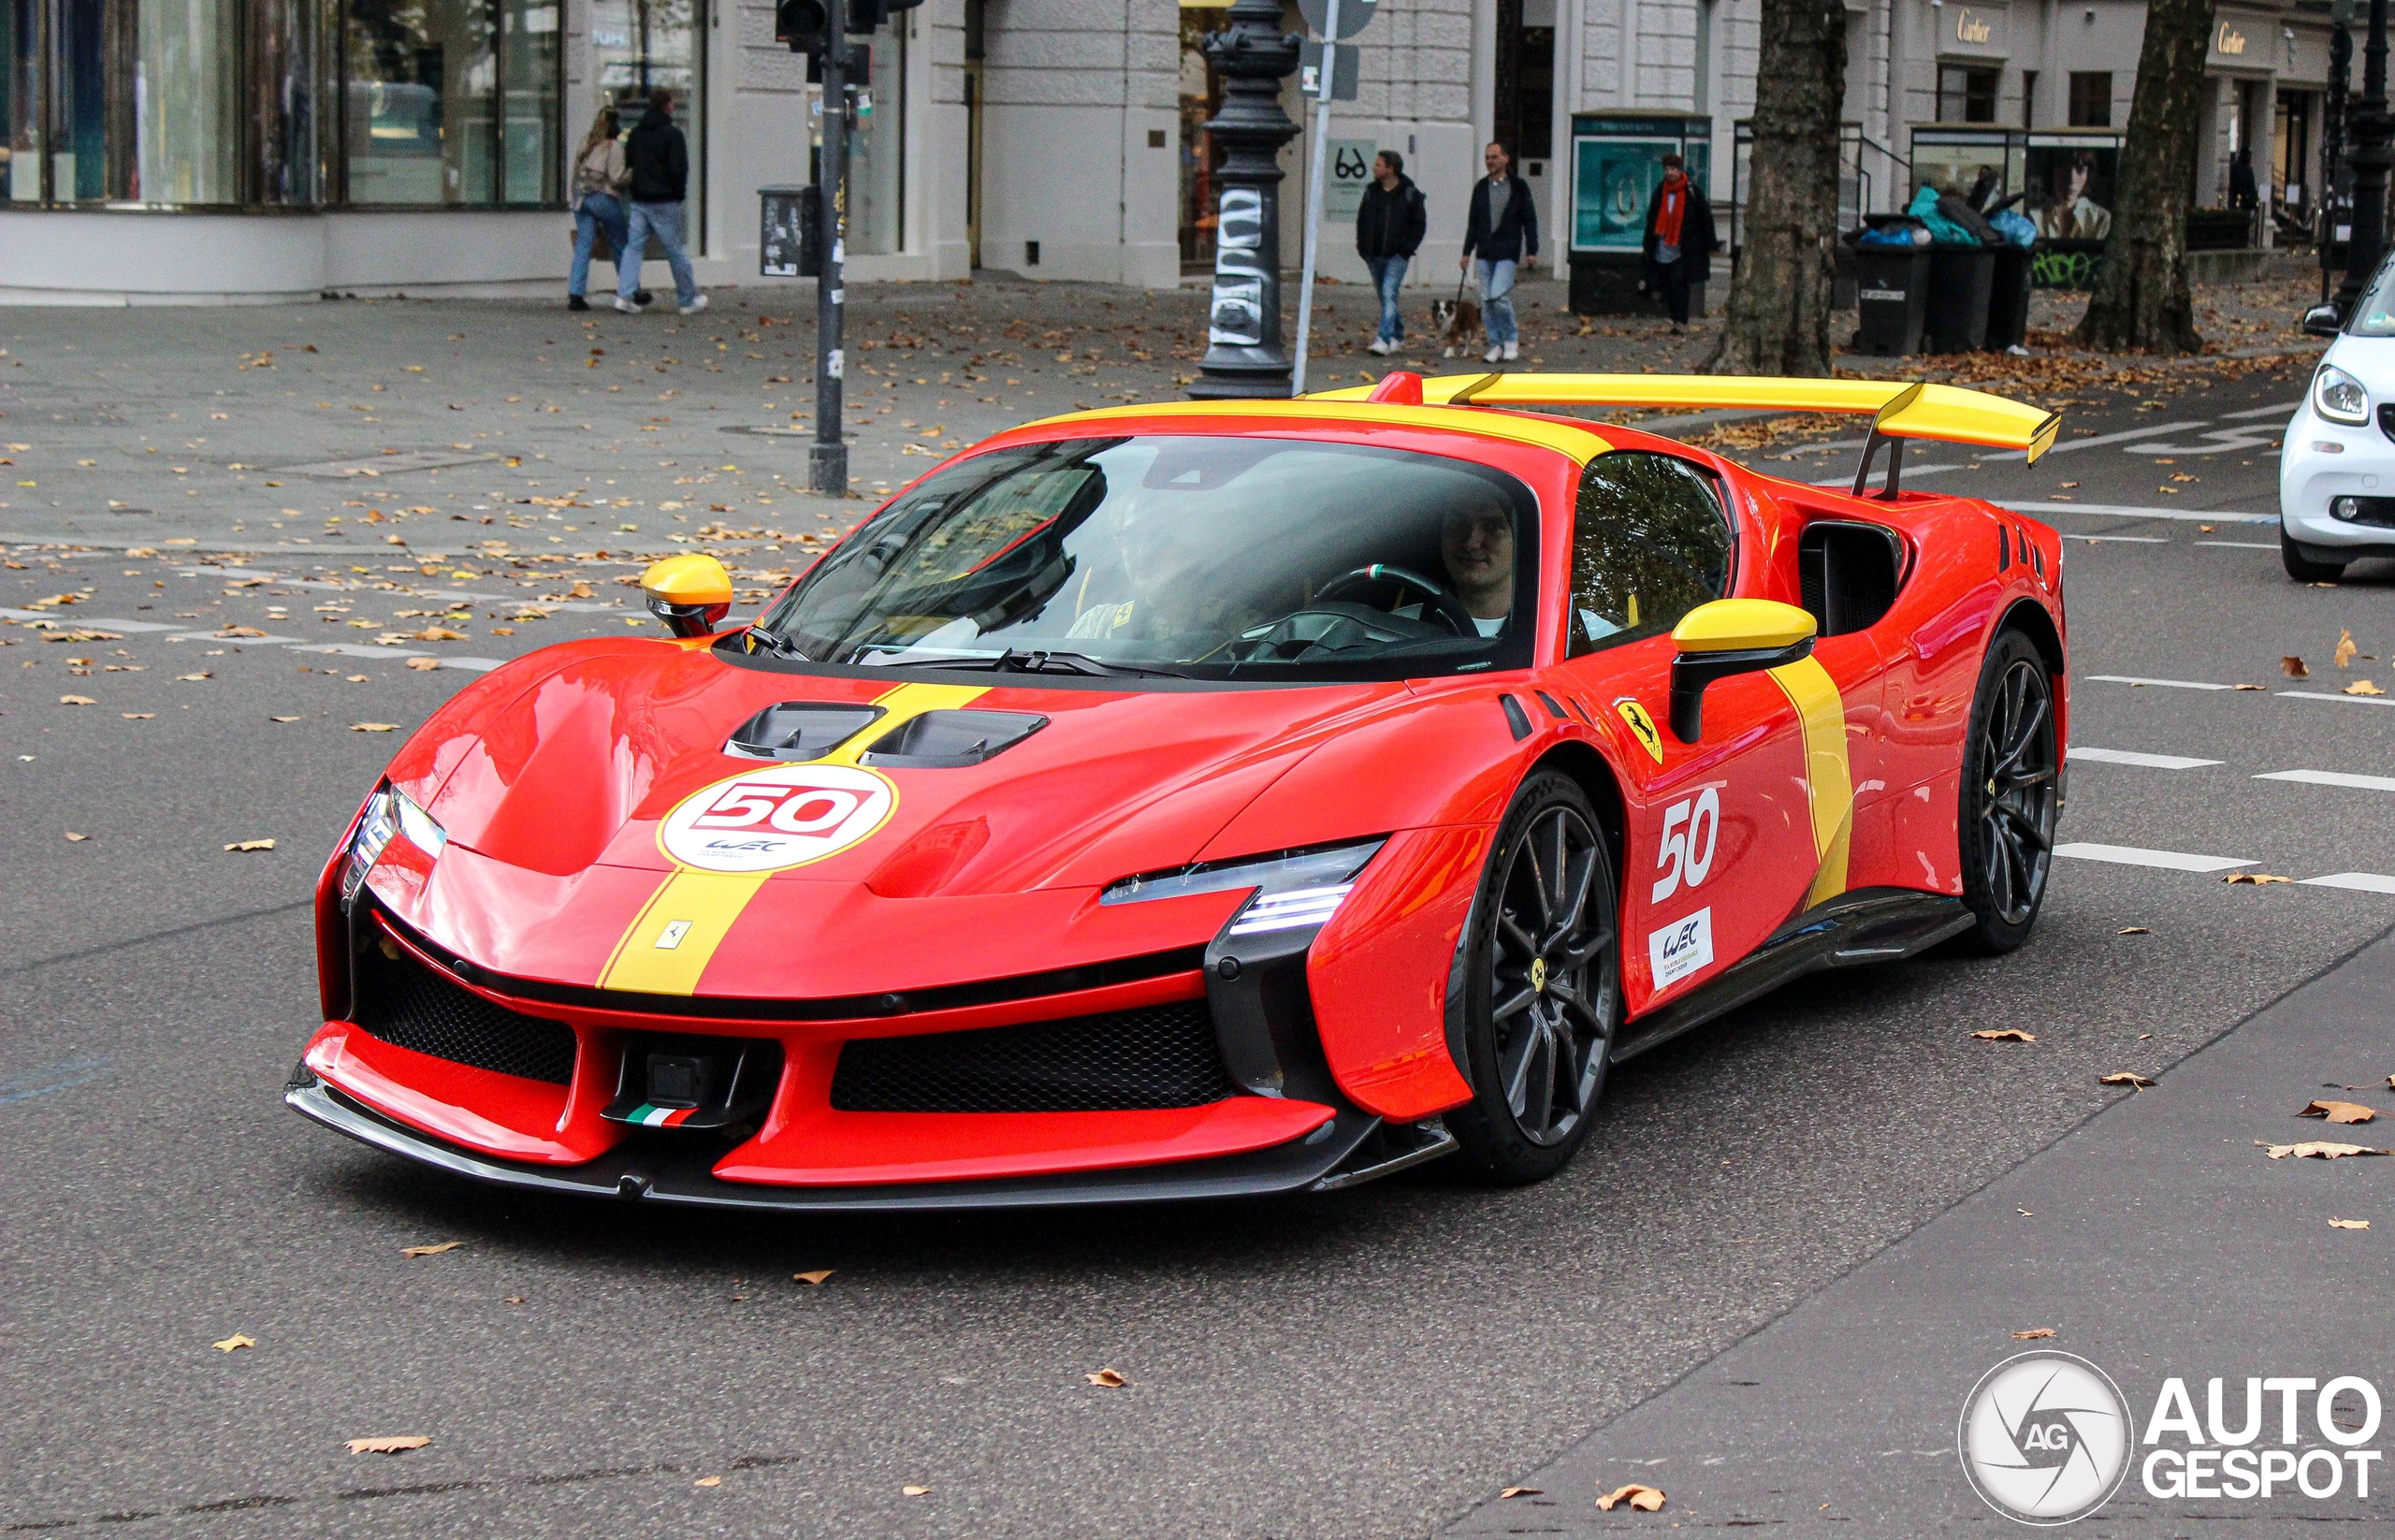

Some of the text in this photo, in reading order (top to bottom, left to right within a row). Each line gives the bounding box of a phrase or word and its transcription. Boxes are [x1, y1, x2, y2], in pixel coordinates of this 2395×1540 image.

[1957, 7, 1990, 43] Cartier
[2218, 21, 2245, 54] Cartier
[694, 785, 858, 833] 50
[705, 839, 787, 852] WEC
[1651, 788, 1720, 905] 50
[1663, 920, 1699, 959] WEC
